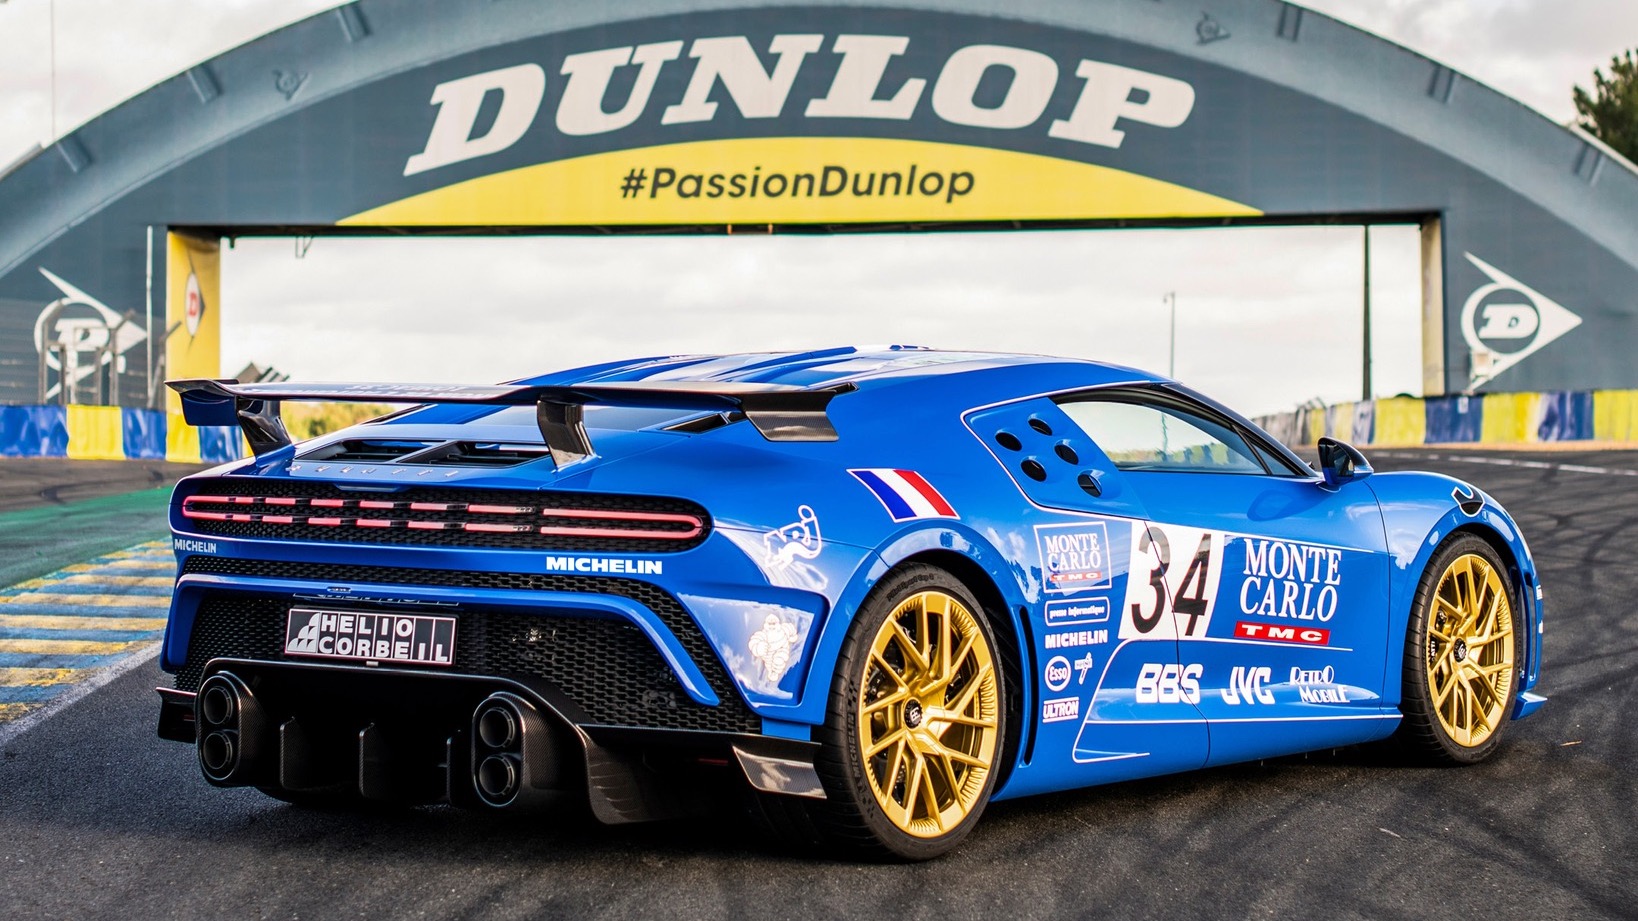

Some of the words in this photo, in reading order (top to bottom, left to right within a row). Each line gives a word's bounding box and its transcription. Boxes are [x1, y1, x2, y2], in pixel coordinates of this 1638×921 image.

[403, 34, 1196, 177] DUNLOP
[620, 164, 976, 203] #PassionDunlop
[174, 538, 217, 554] MICHELIN
[1044, 533, 1100, 554] MONTE
[546, 556, 663, 575] MICHELIN
[1047, 550, 1101, 571] CARLO
[1243, 538, 1341, 585] MONTE
[1131, 526, 1212, 637] 34
[1240, 576, 1338, 622] CARLO
[320, 614, 413, 638] HELIO
[1241, 624, 1324, 642] TMC
[318, 636, 448, 662] CORBEIL
[1045, 629, 1109, 649] MICHELIN
[1136, 663, 1203, 704] BBS
[1220, 666, 1276, 705] JVC
[1042, 700, 1079, 719] ULTRON
